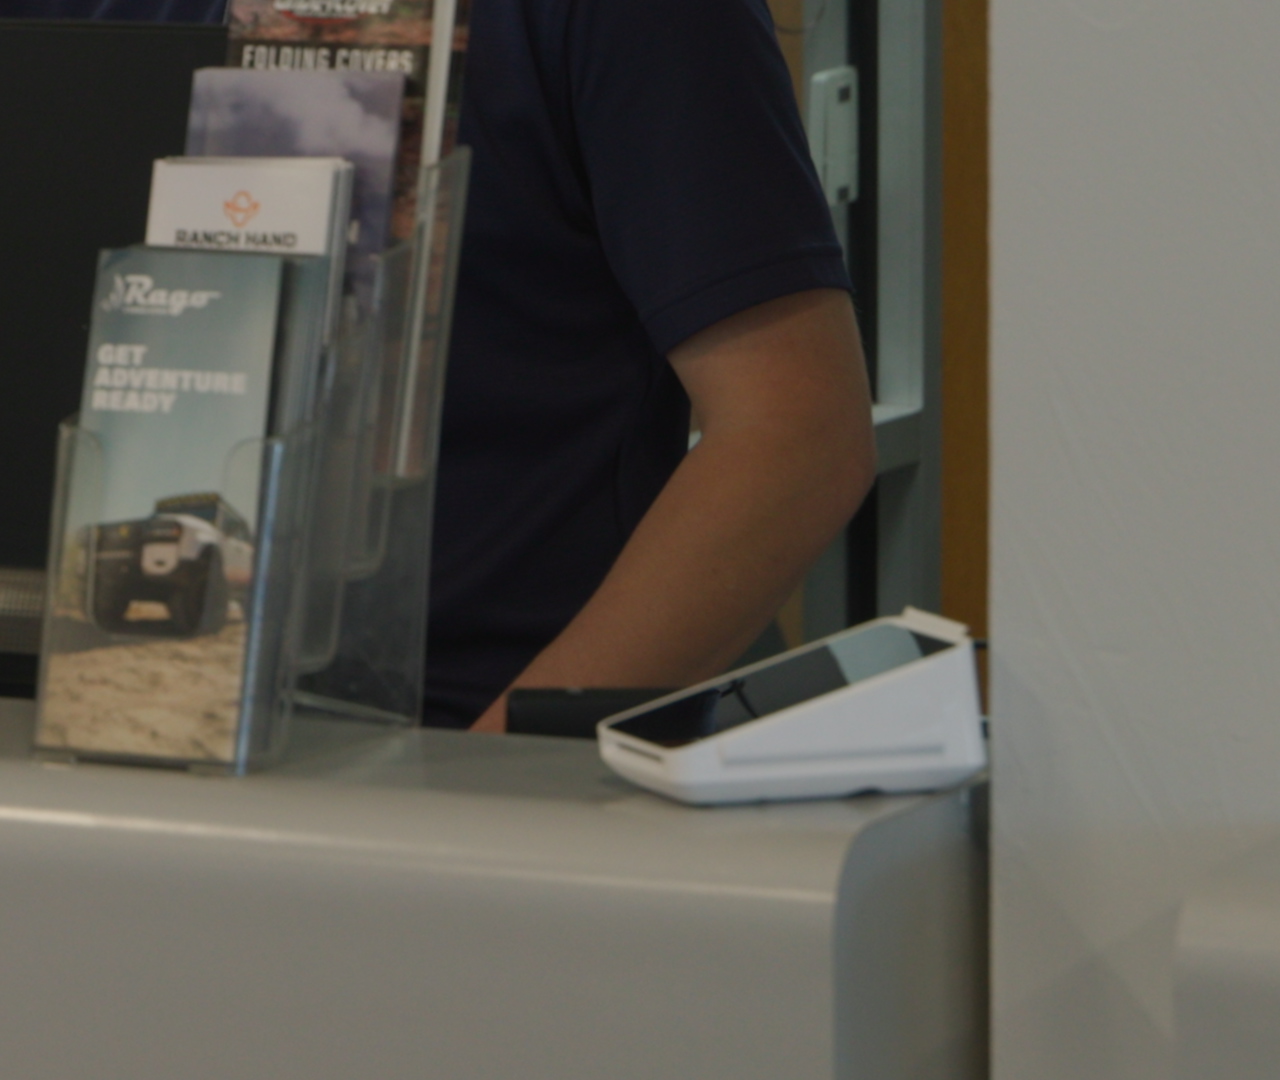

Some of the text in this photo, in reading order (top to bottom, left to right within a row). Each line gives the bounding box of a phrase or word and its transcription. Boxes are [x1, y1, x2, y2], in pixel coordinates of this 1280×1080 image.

[241, 44, 414, 74] FOLDING COVERS
[175, 229, 298, 248] RANCH HAND
[123, 273, 222, 317] Rago
[96, 343, 148, 366] GET
[93, 367, 248, 395] ADVENTURE
[91, 389, 178, 413] READY
